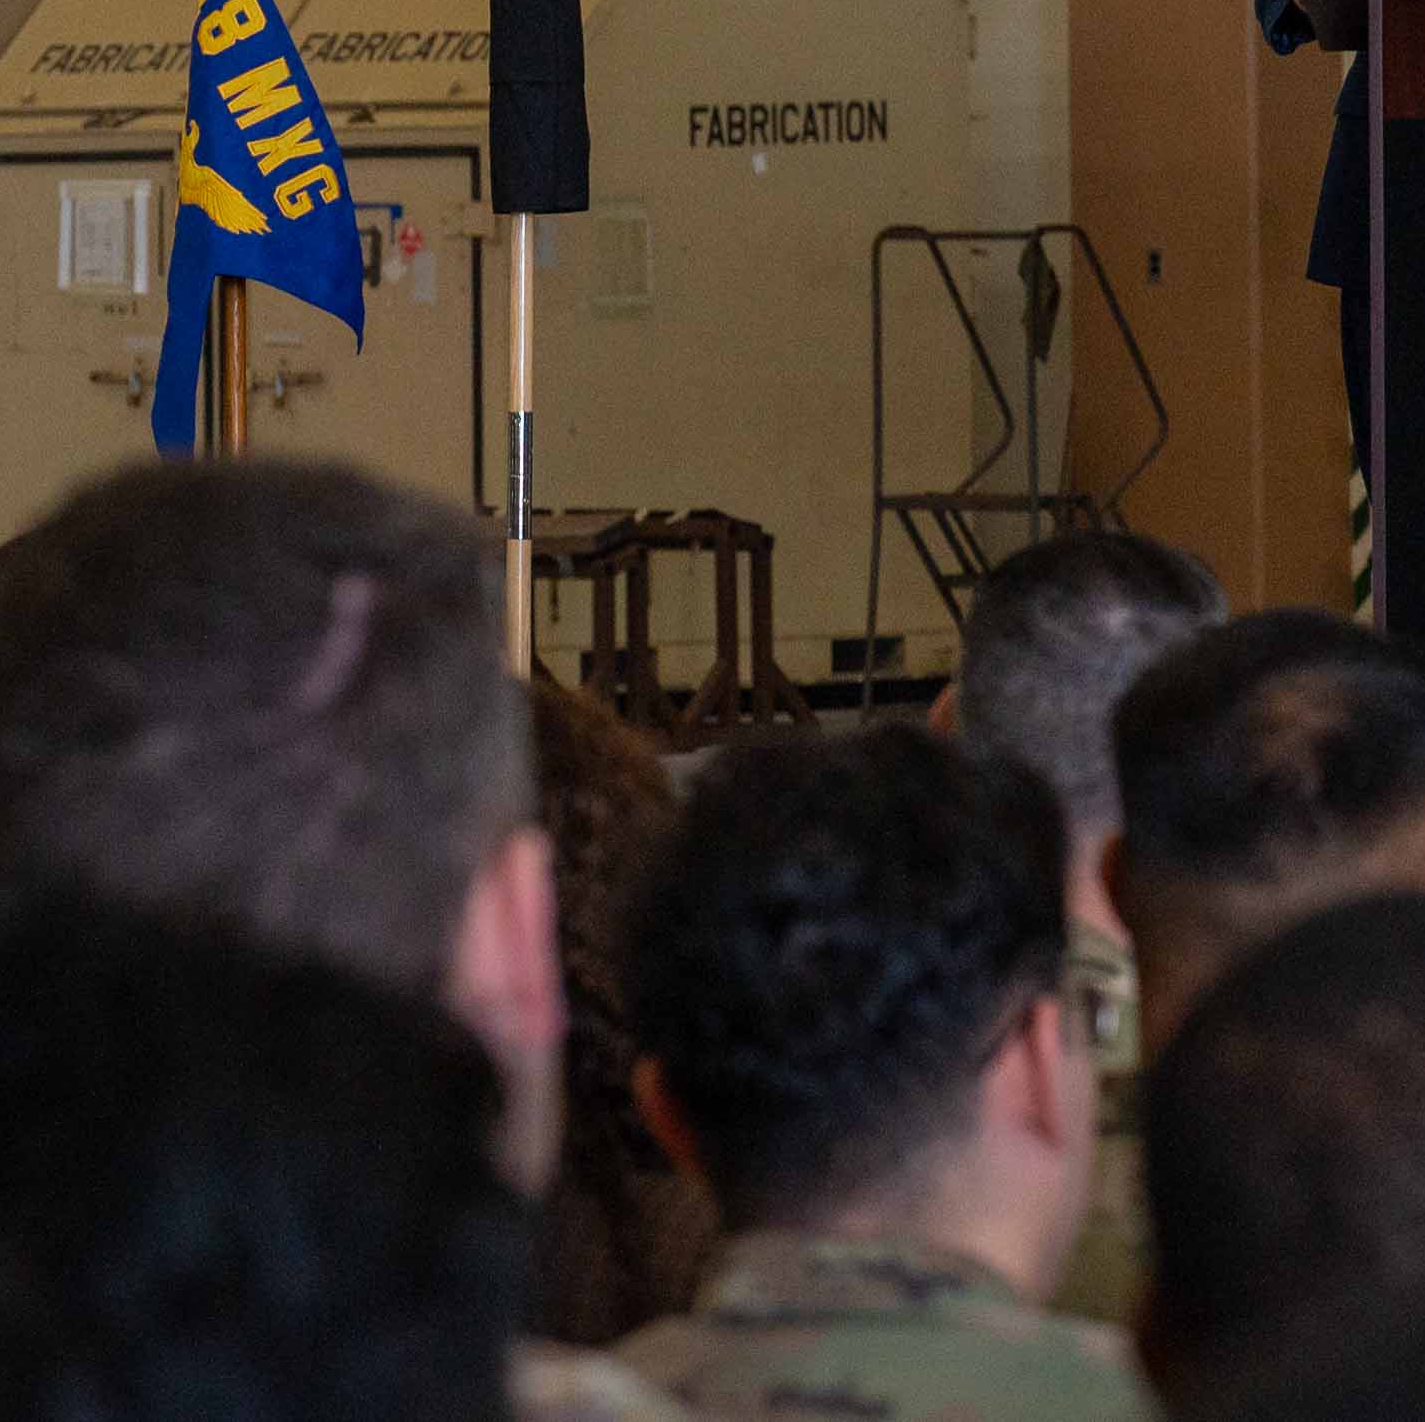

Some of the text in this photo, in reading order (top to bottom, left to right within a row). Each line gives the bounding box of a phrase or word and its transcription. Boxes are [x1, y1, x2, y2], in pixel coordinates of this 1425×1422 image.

[29, 41, 192, 75] FABRICATI
[299, 29, 491, 64] FABRICATIO
[216, 56, 342, 221] MXG
[688, 97, 889, 149] FABRICATION
